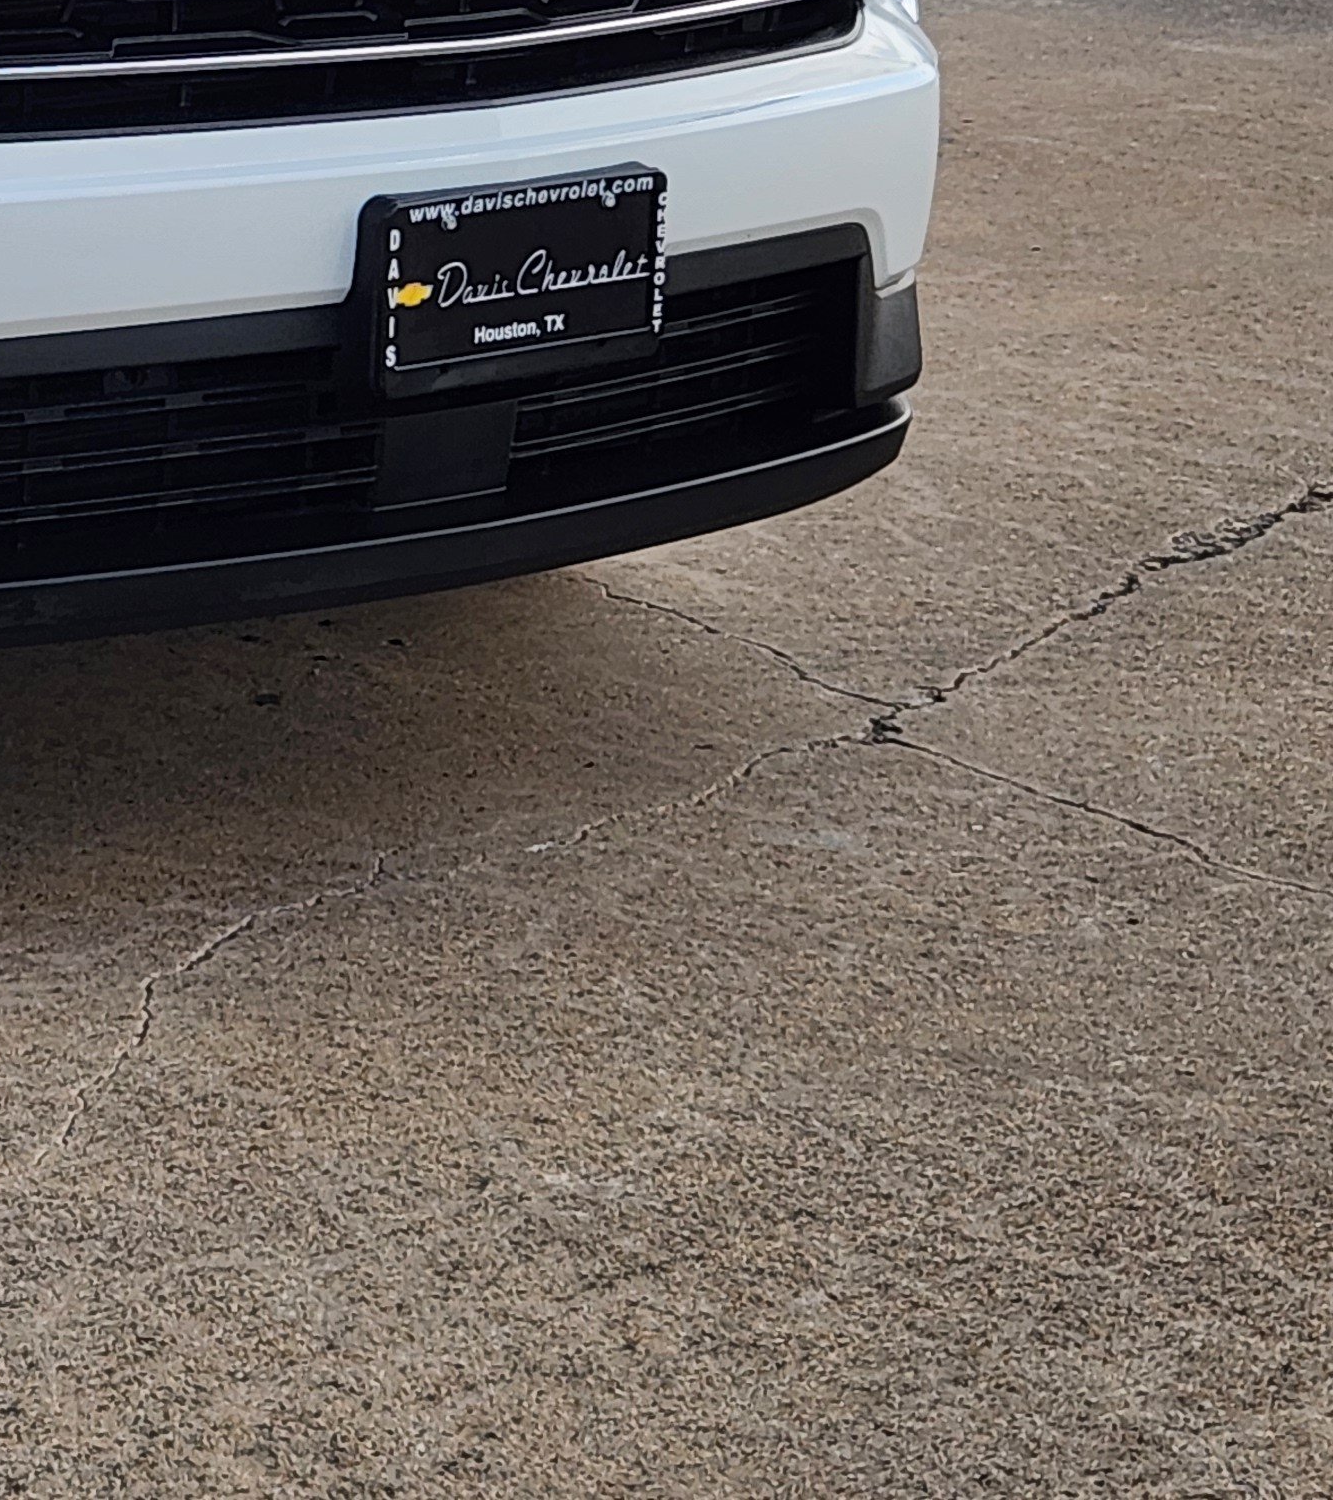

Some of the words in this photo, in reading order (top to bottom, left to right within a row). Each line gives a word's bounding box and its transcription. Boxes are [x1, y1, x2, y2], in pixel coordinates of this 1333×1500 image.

[409, 176, 654, 223] www.davischevrolet.com
[437, 261, 515, 307] Davis
[516, 249, 651, 296] Chevrolet
[473, 321, 541, 344] Houston,
[543, 313, 566, 332] TX
